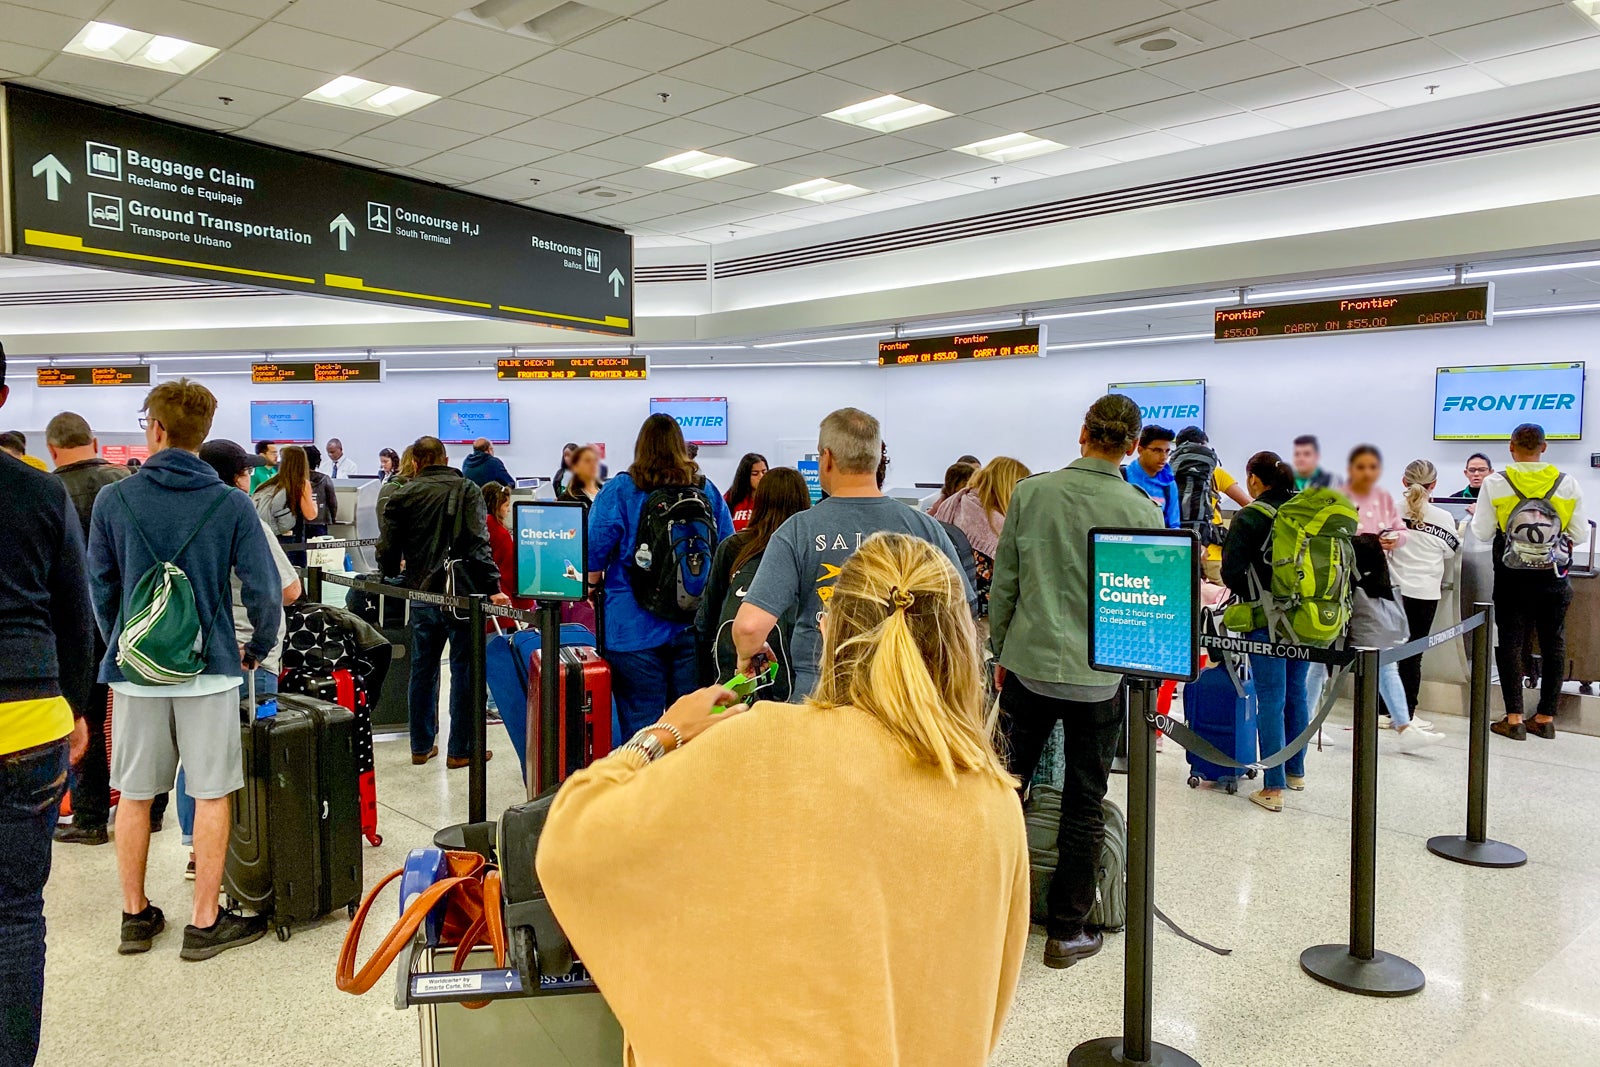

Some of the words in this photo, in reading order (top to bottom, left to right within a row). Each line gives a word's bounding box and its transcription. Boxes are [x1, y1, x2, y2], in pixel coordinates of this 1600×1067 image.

[127, 150, 204, 181] Baggage
[210, 168, 255, 190] Claim
[128, 173, 178, 193] Reclamo
[180, 184, 194, 196] de
[198, 187, 243, 206] Equipaje
[128, 200, 194, 225] Ground
[198, 212, 312, 245] Transportation
[395, 207, 459, 232] Concourse
[462, 221, 480, 237] H,J
[130, 223, 190, 243] Transporte
[193, 233, 232, 249] Urbano
[395, 226, 417, 239] South
[419, 230, 451, 245] Terminal
[531, 236, 582, 257] Restrooms
[563, 258, 582, 270] Baños
[1216, 309, 1266, 322] Frontier
[1340, 297, 1398, 311] Frontier
[1223, 326, 1259, 338] $55.00
[1284, 322, 1319, 334] CARRY
[1324, 320, 1340, 331] ON
[1346, 316, 1388, 329] $55.00
[1417, 311, 1459, 324] CARRY
[1466, 309, 1483, 321] ON
[879, 342, 911, 351] Frontier
[954, 334, 989, 345] Frontier
[523, 359, 554, 367] CHECK-IN
[597, 358, 629, 366] CHECK-IN
[897, 354, 919, 364] CARRY
[920, 353, 931, 362] ON
[932, 351, 958, 362] $55.00
[973, 348, 997, 358] CARRY
[1000, 346, 1011, 356] ON
[1139, 404, 1200, 419] ONTIER
[1442, 393, 1576, 412] FRONTIER
[675, 416, 724, 427] ONTIER
[521, 528, 572, 540] Check-in
[1099, 572, 1151, 589] Ticket
[1099, 588, 1167, 606] Counter
[1099, 606, 1124, 617] Opens
[1125, 608, 1131, 616] 2
[1132, 608, 1154, 618] hours
[1155, 612, 1175, 621] prior
[1099, 615, 1108, 623] to
[1109, 616, 1147, 627] departure
[1200, 635, 1310, 660] YFRONTIER.COM
